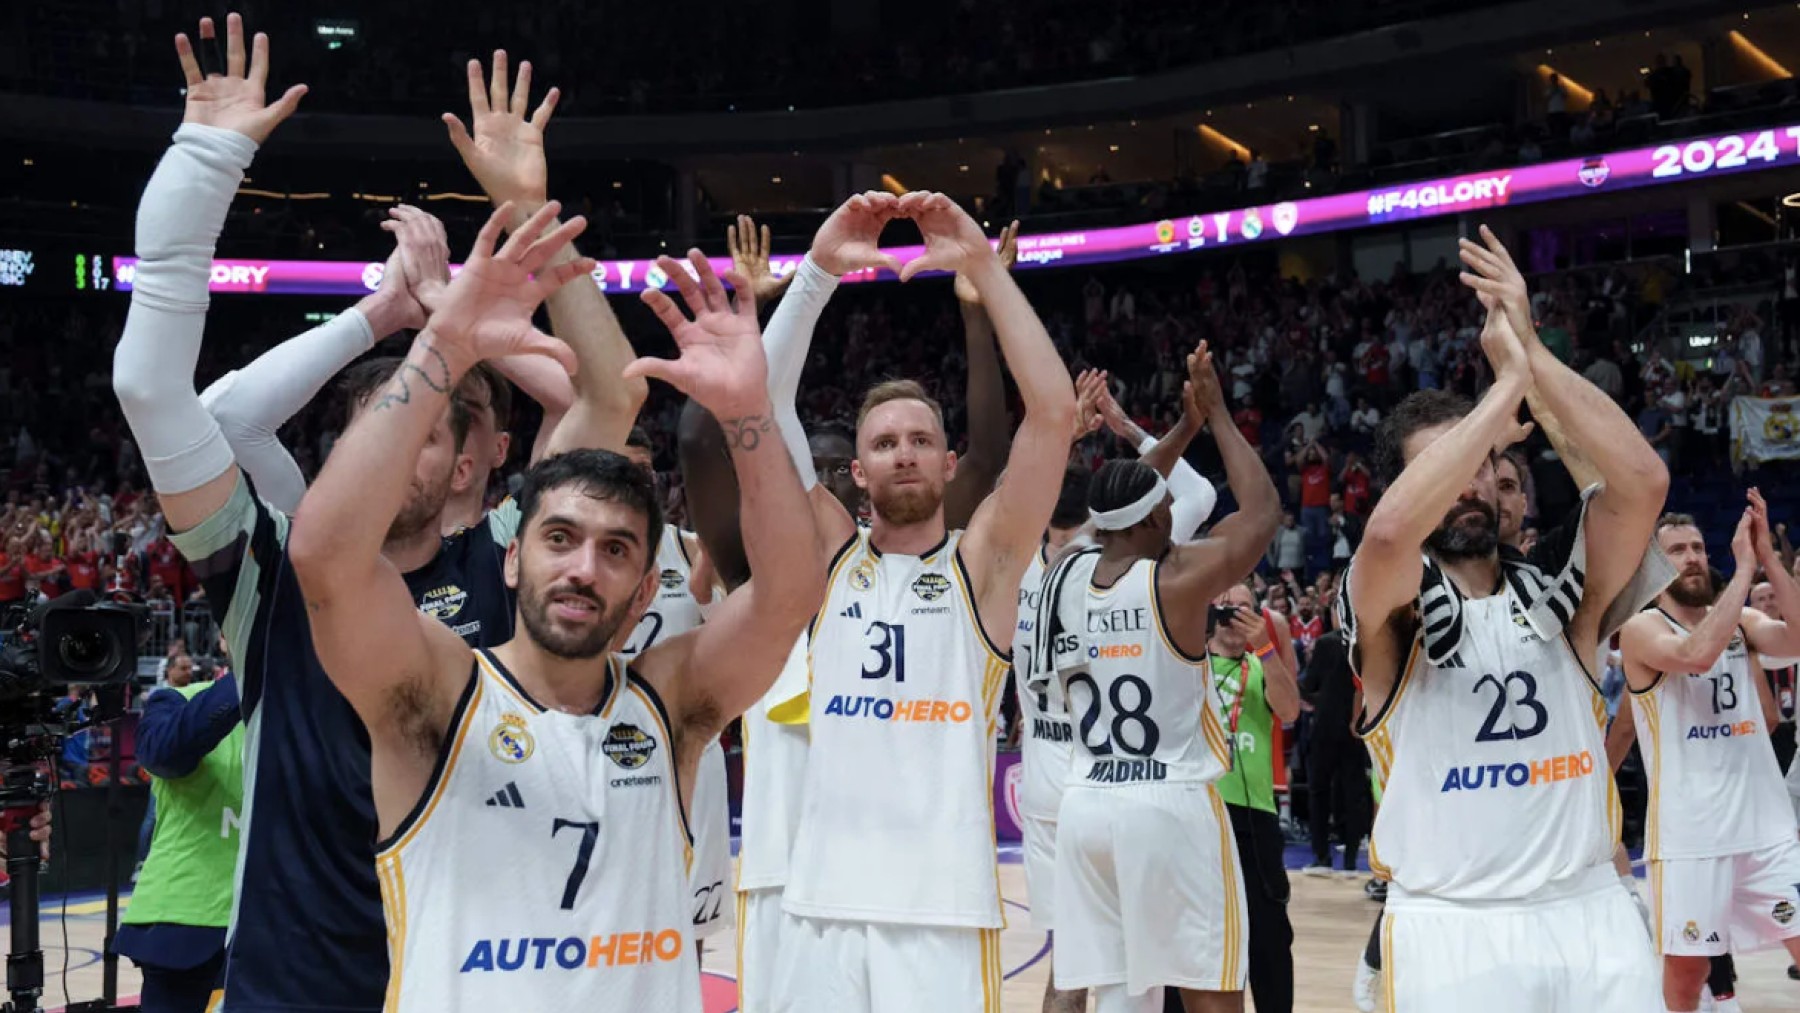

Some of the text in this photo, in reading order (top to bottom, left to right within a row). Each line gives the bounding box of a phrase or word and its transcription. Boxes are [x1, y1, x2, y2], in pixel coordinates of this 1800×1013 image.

[1652, 130, 1779, 178] 2024
[1367, 175, 1512, 215] #F4GLORY
[1017, 248, 1063, 264] League
[621, 612, 663, 653] 2
[1087, 608, 1147, 633] USELE
[861, 621, 905, 682] 31
[1088, 644, 1143, 659] OHERO
[825, 695, 972, 723] AUTOHERO
[1472, 670, 1549, 742] 23
[1708, 673, 1738, 714] 13
[1033, 718, 1073, 742] MADR
[1066, 672, 1160, 758] 28
[611, 775, 662, 788] oneteam
[1086, 759, 1167, 783] MADRID
[1441, 751, 1594, 792] AUTOHERO
[552, 818, 599, 910] 7
[460, 928, 682, 973] AUTOHERO
